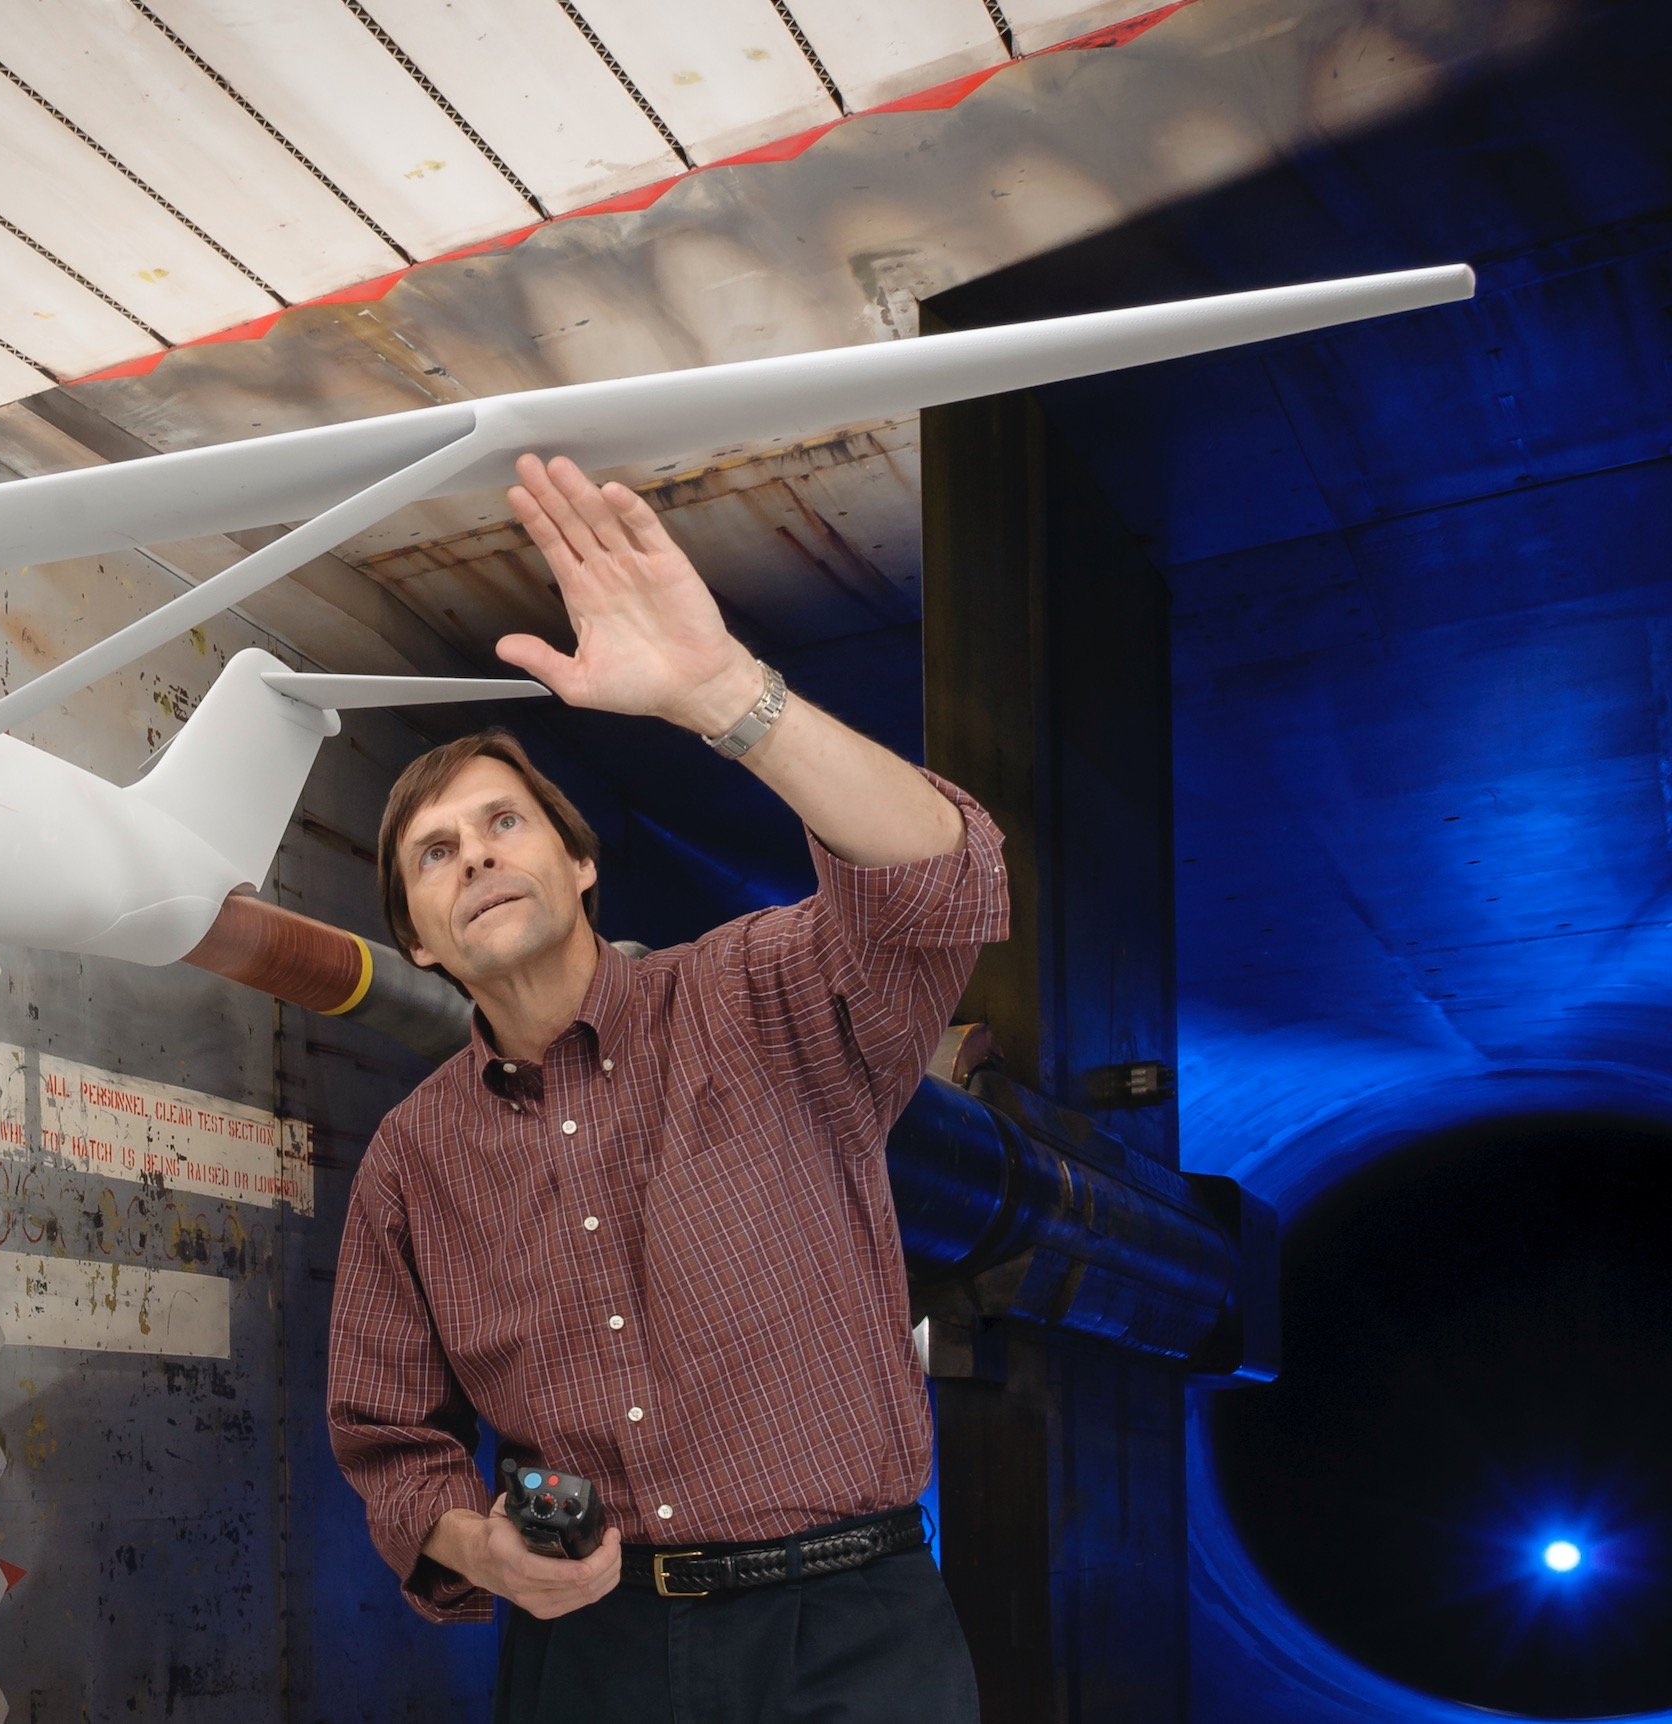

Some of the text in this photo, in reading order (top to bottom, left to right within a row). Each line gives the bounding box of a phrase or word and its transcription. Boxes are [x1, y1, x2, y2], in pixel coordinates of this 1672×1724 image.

[45, 1073, 275, 1147] ALL PERSONNEL CLEAR TEST SECTION
[0, 1120, 26, 1146] WHE
[72, 1136, 113, 1164] HATCH
[122, 1146, 136, 1168] IS
[143, 1152, 181, 1178] BEING
[187, 1161, 229, 1188] RAISED
[234, 1170, 249, 1191] OR
